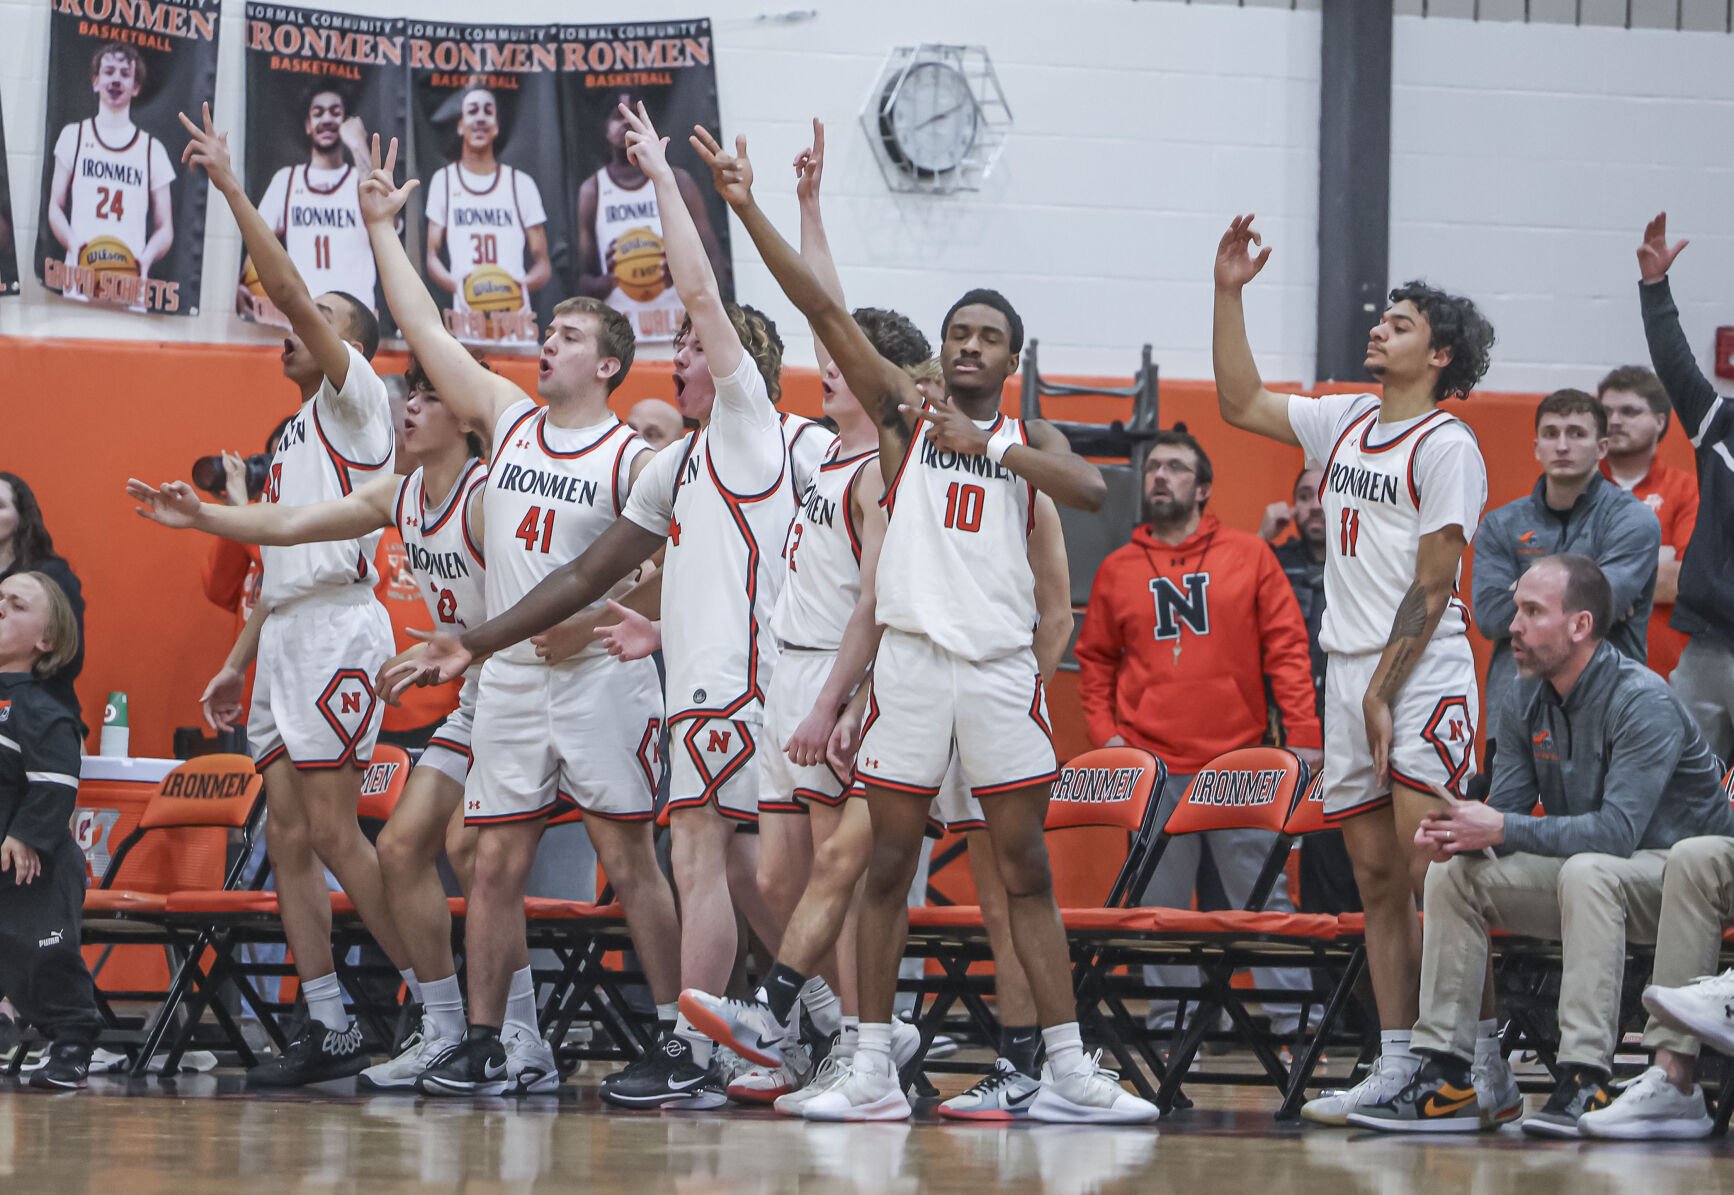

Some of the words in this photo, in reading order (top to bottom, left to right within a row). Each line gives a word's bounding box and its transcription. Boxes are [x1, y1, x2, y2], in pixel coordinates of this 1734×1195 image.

[78, 21, 172, 52] BASKETBALL
[311, 13, 392, 34] COMMUNITY
[270, 55, 362, 81] BASKETBALL
[431, 73, 519, 89] BASKETBALL
[585, 72, 672, 88] BASKETBALL
[82, 158, 143, 187] IRONMEN
[96, 186, 124, 222] 24
[291, 206, 356, 228] IRONMEN
[454, 208, 513, 226] IRONMEN
[86, 248, 128, 265] Wilson
[315, 235, 331, 270] 11
[470, 233, 497, 265] 30
[497, 463, 598, 507] IRONMEN
[944, 481, 986, 533] 10
[515, 505, 556, 554] 41
[1340, 506, 1360, 557] 11
[1149, 572, 1210, 641] N
[341, 691, 361, 714] N
[707, 729, 732, 754] N
[1449, 719, 1465, 742] N
[160, 772, 255, 799] IRONMEN
[1050, 767, 1145, 803] IRONMEN
[1188, 769, 1286, 806] IRONMEN
[38, 936, 60, 948] PUMA
